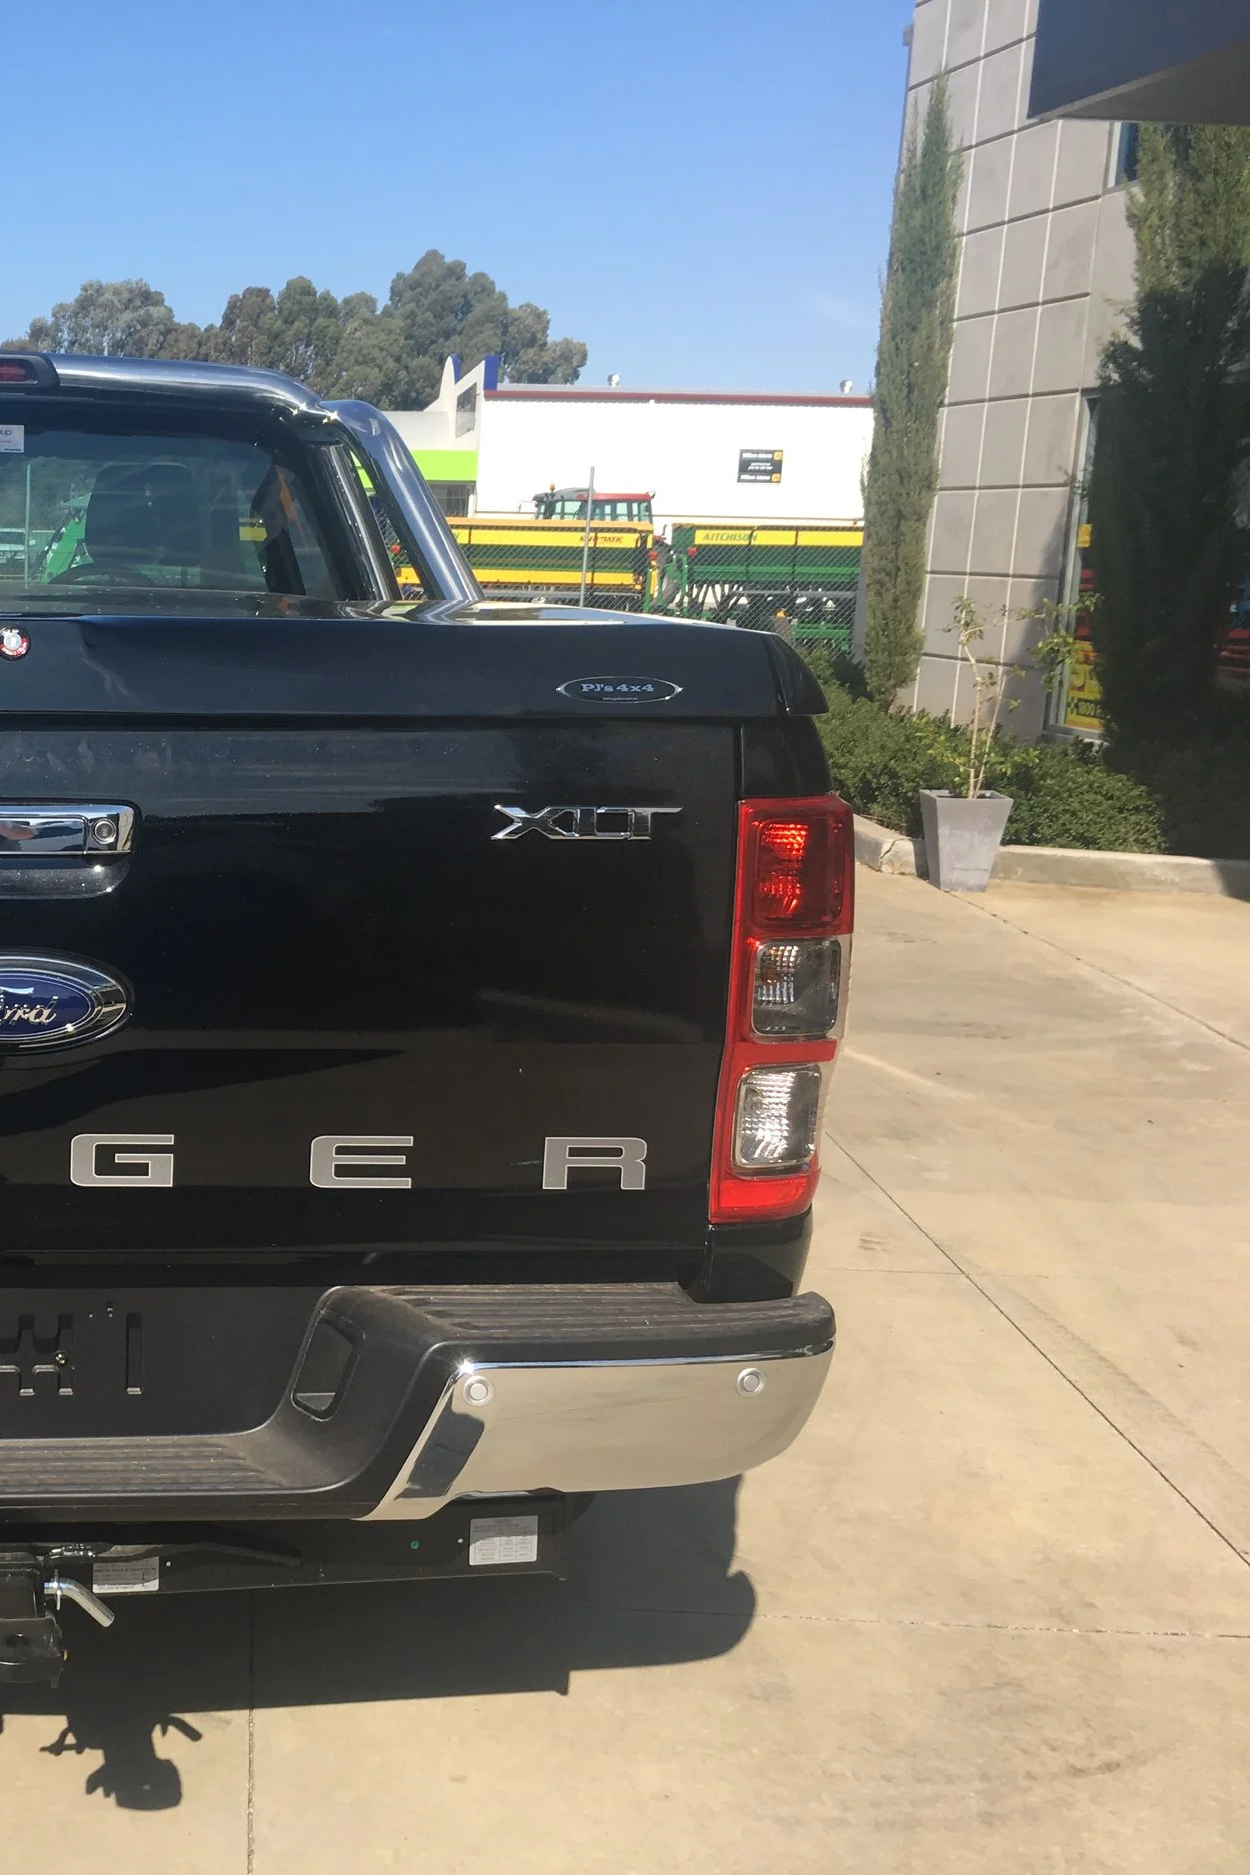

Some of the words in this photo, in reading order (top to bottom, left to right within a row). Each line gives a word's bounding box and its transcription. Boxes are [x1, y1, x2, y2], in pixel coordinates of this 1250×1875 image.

[580, 683, 614, 692] PJ's
[616, 683, 655, 692] 4x4
[490, 804, 684, 841] XLT
